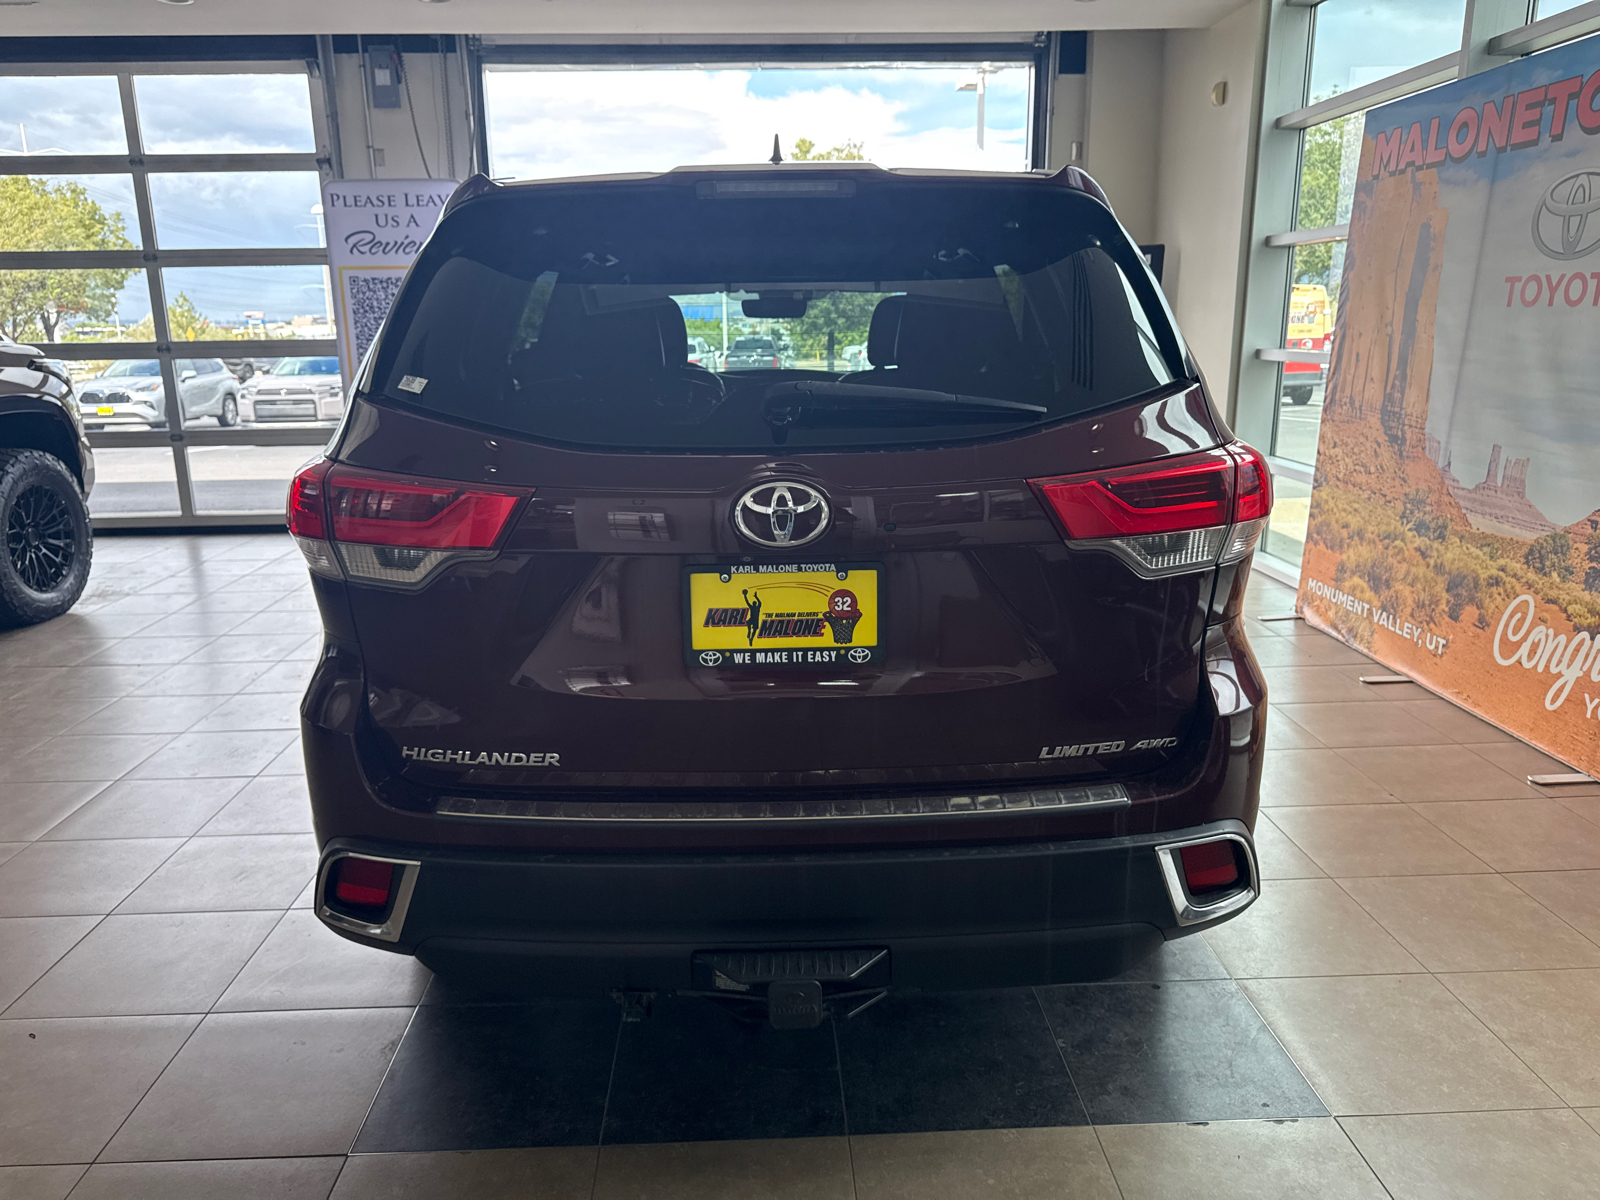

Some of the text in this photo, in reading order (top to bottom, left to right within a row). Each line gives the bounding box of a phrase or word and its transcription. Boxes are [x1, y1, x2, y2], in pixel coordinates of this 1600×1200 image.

[330, 192, 450, 208] PLEASE LEAV
[374, 213, 420, 228] US A
[731, 563, 836, 574] KARL MALONE TOYOTA
[834, 596, 852, 611] 32
[703, 607, 749, 627] KARL
[1307, 577, 1447, 655] MONUMENT VALLEY, UT
[757, 618, 825, 638] MALONE
[734, 650, 837, 664] WE MAKE IT EASY
[401, 746, 561, 767] HIGHLANDER
[1038, 737, 1178, 759] LIMITED AWD
